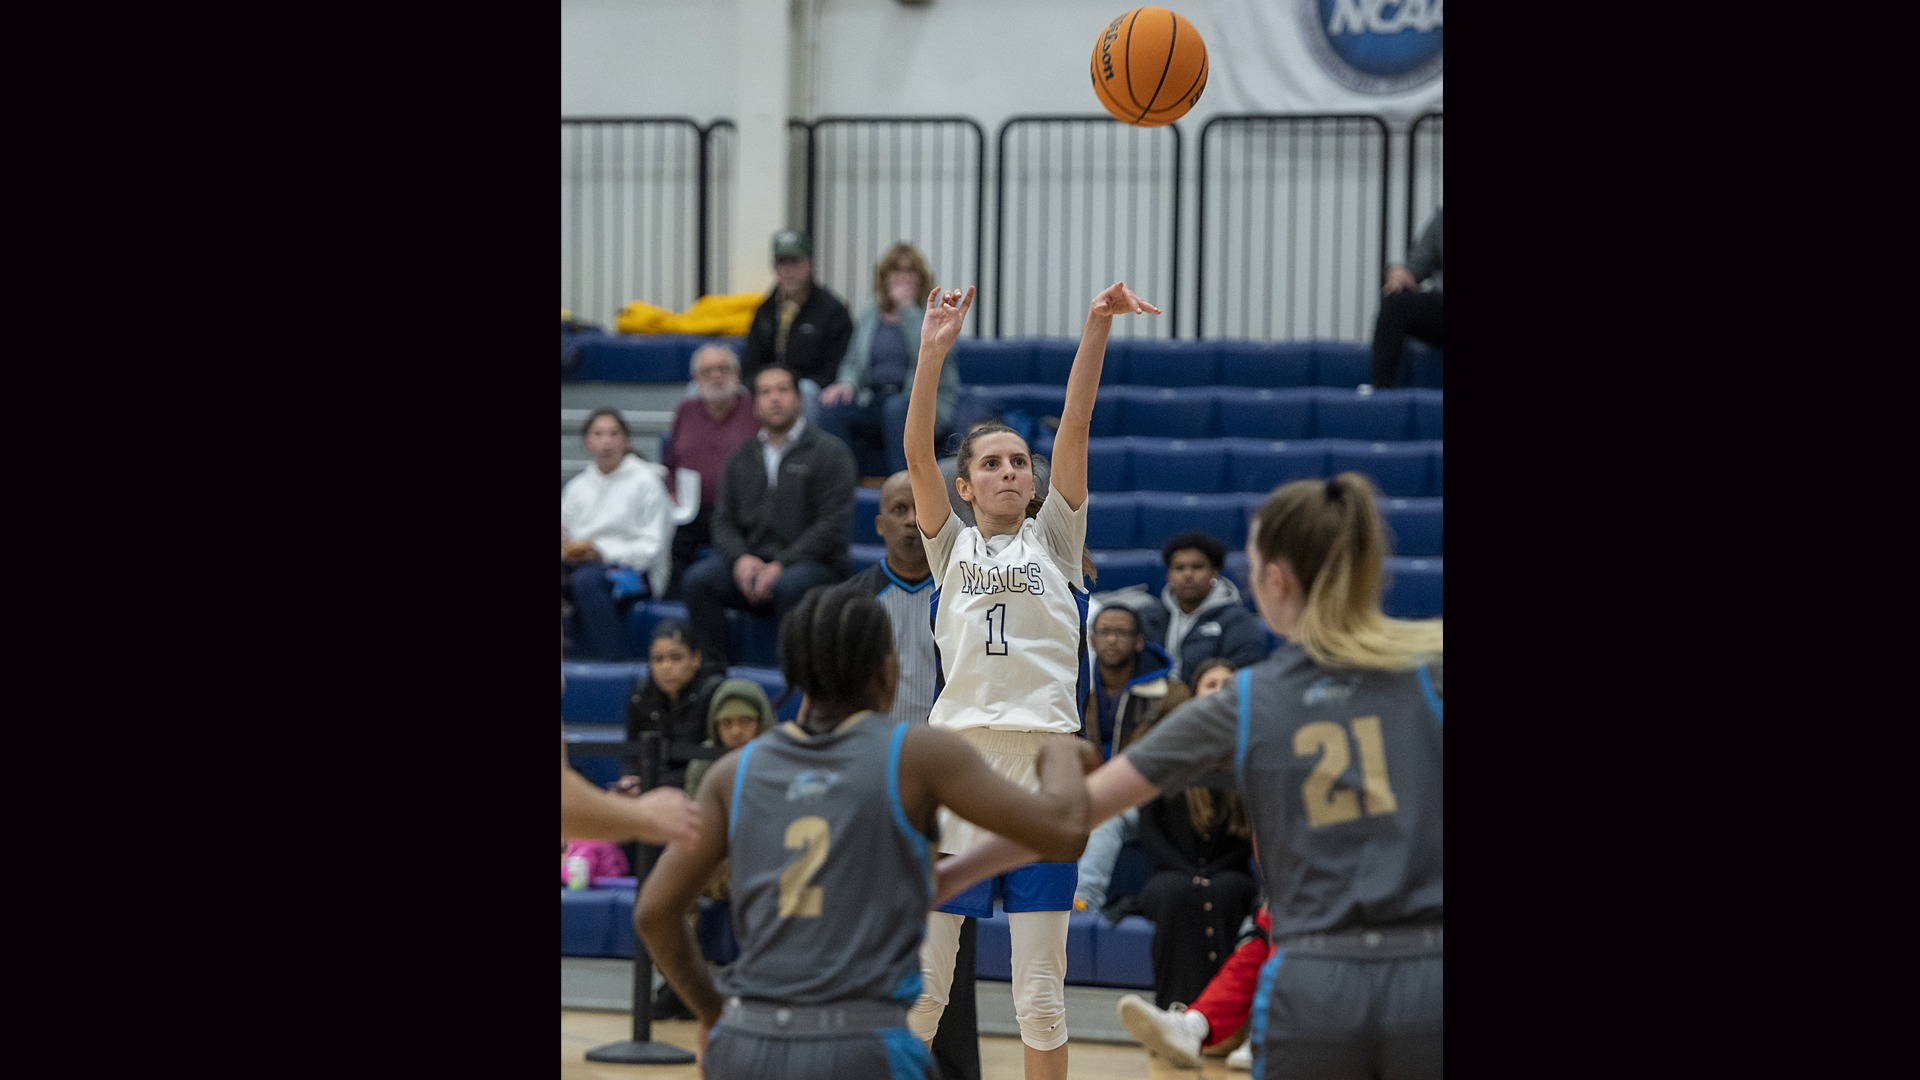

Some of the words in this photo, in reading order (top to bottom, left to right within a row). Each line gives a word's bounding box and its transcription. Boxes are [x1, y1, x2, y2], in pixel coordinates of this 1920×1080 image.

[960, 561, 1045, 596] MACS
[986, 603, 1008, 656] 1
[1293, 716, 1397, 828] 21
[779, 815, 830, 918] 2
